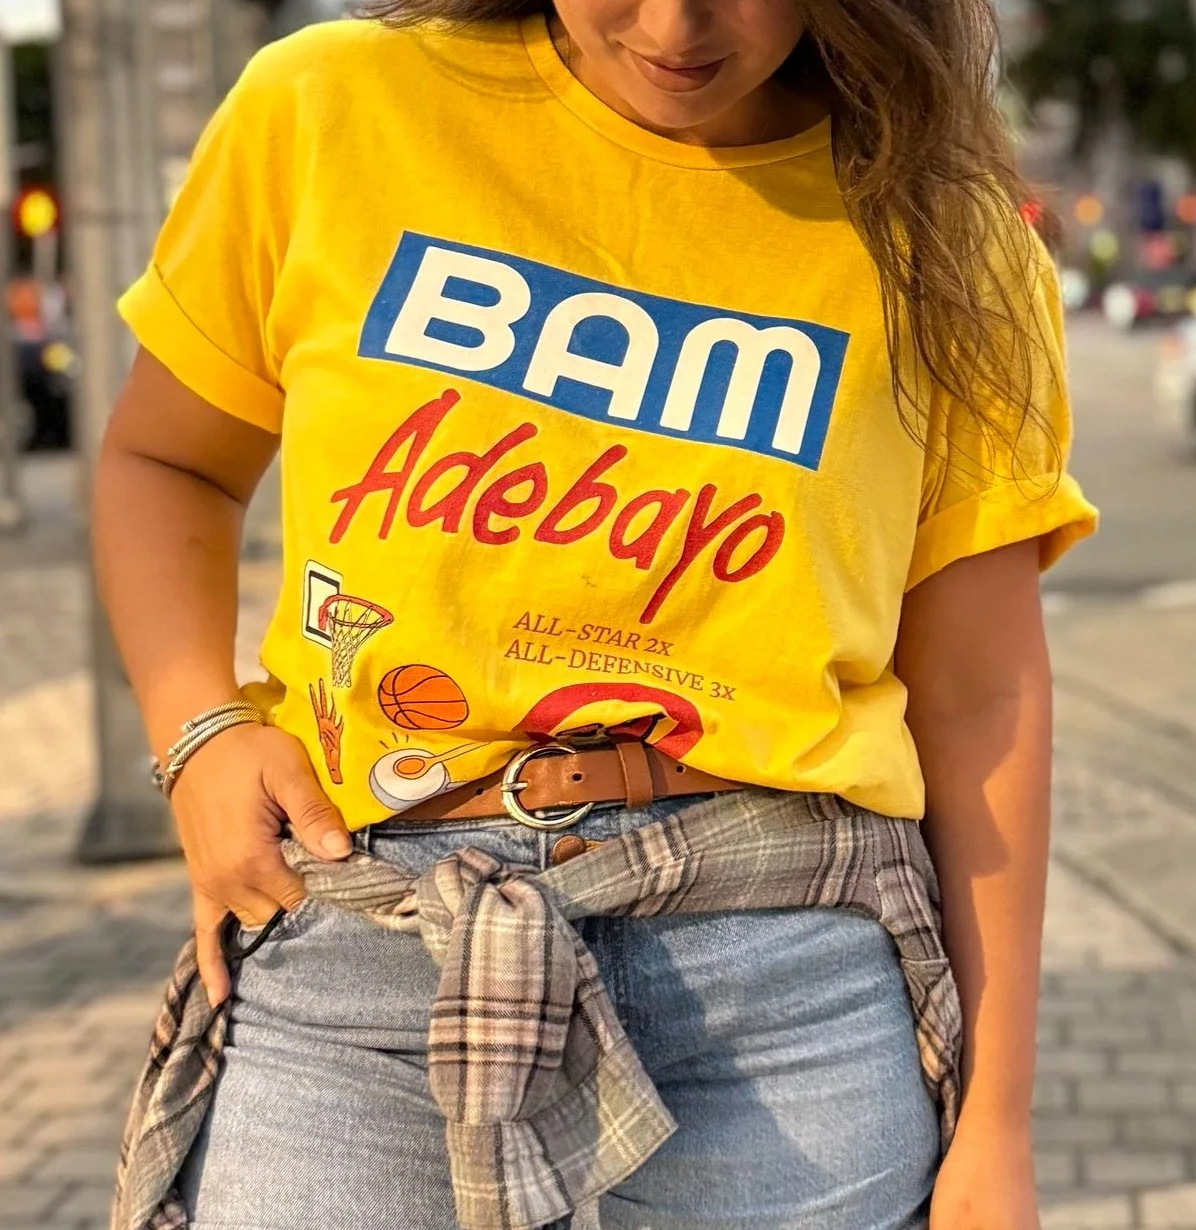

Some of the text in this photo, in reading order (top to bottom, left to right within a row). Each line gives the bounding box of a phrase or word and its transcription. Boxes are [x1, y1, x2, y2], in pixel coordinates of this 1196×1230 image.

[384, 245, 821, 456] BAM
[328, 388, 785, 624] Adebayo
[504, 639, 736, 701] ALL-DEFENSIVE 3X
[513, 611, 674, 656] ALL-STAR 2X
